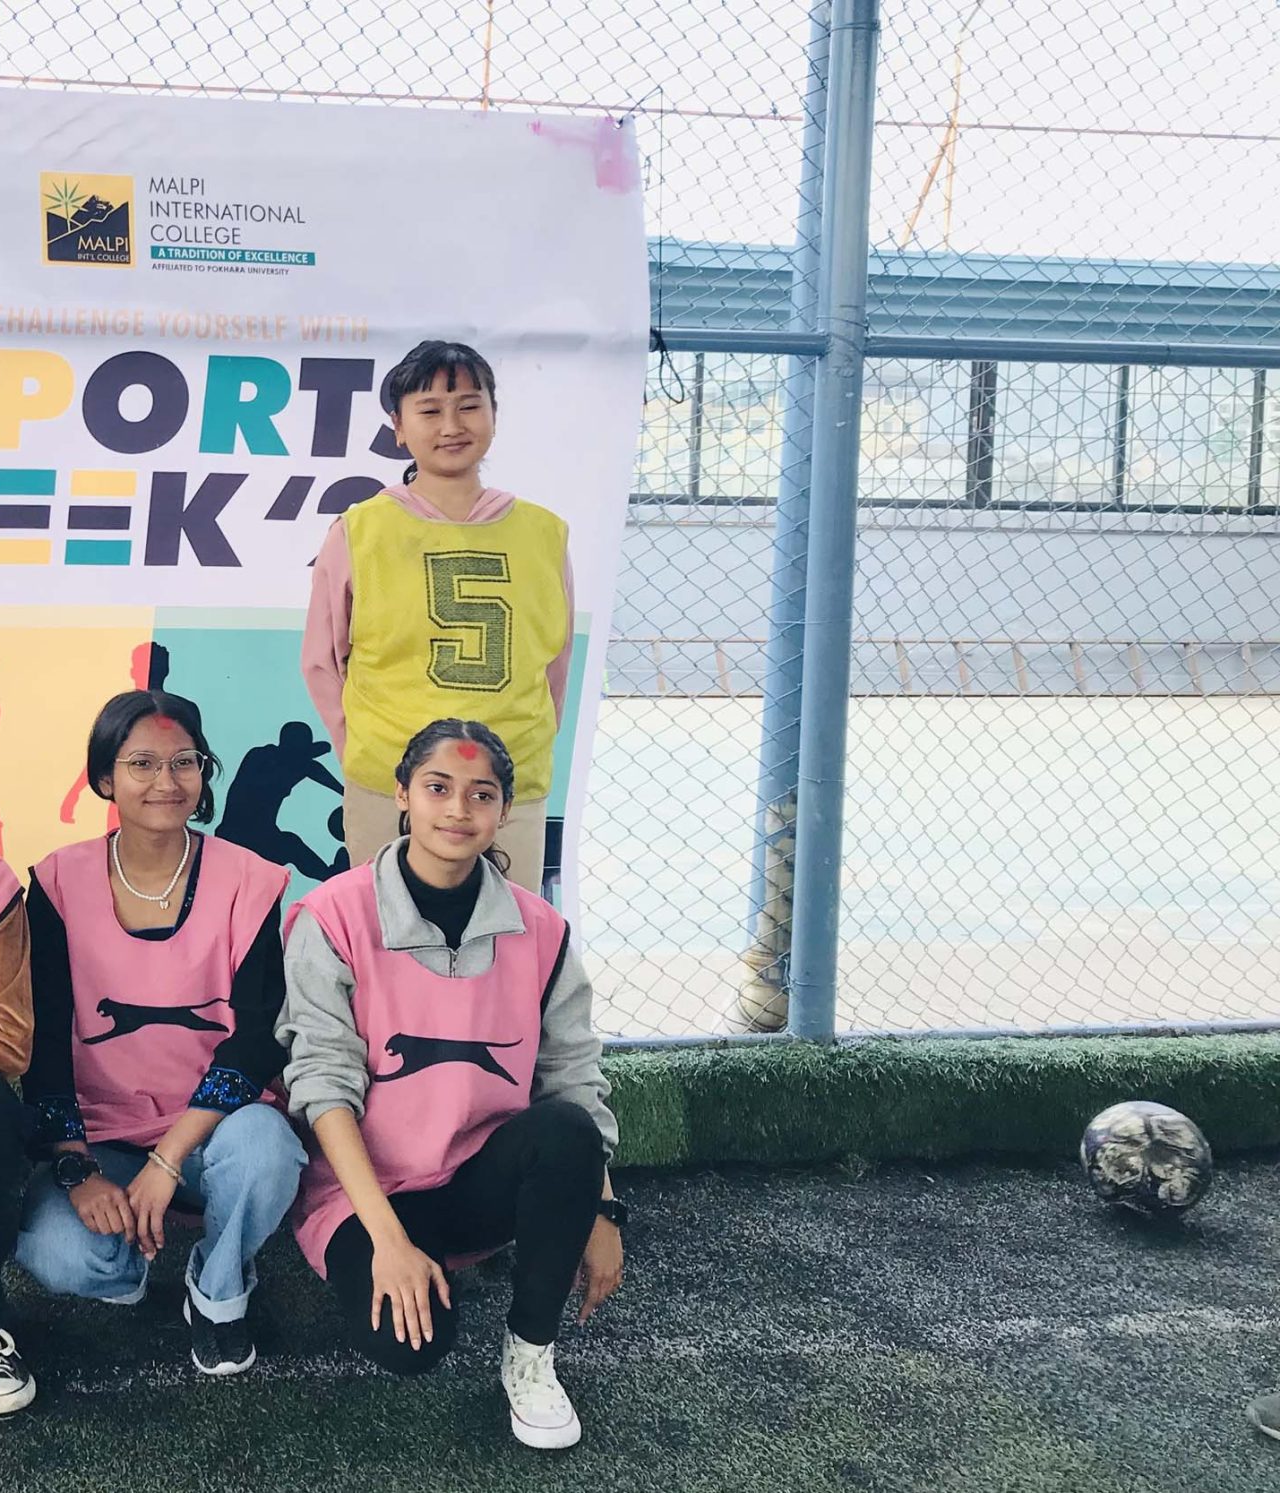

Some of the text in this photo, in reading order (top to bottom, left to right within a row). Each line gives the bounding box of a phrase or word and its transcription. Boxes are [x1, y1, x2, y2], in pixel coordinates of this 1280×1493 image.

[149, 177, 205, 196] MALPI
[150, 200, 305, 224] INTERNATIONAL
[78, 235, 129, 252] MALPI
[150, 224, 241, 245] COLLEGE
[97, 253, 130, 263] COLLEGE
[157, 247, 308, 264] A TRADITION OF EXCELLENCE
[151, 263, 193, 272] AFFILIATED
[207, 265, 246, 274] POKHARA
[247, 267, 290, 276] UNIVERSITY
[156, 310, 288, 341] YOURSELF
[299, 314, 369, 343] WITH
[423, 550, 513, 693] 5
